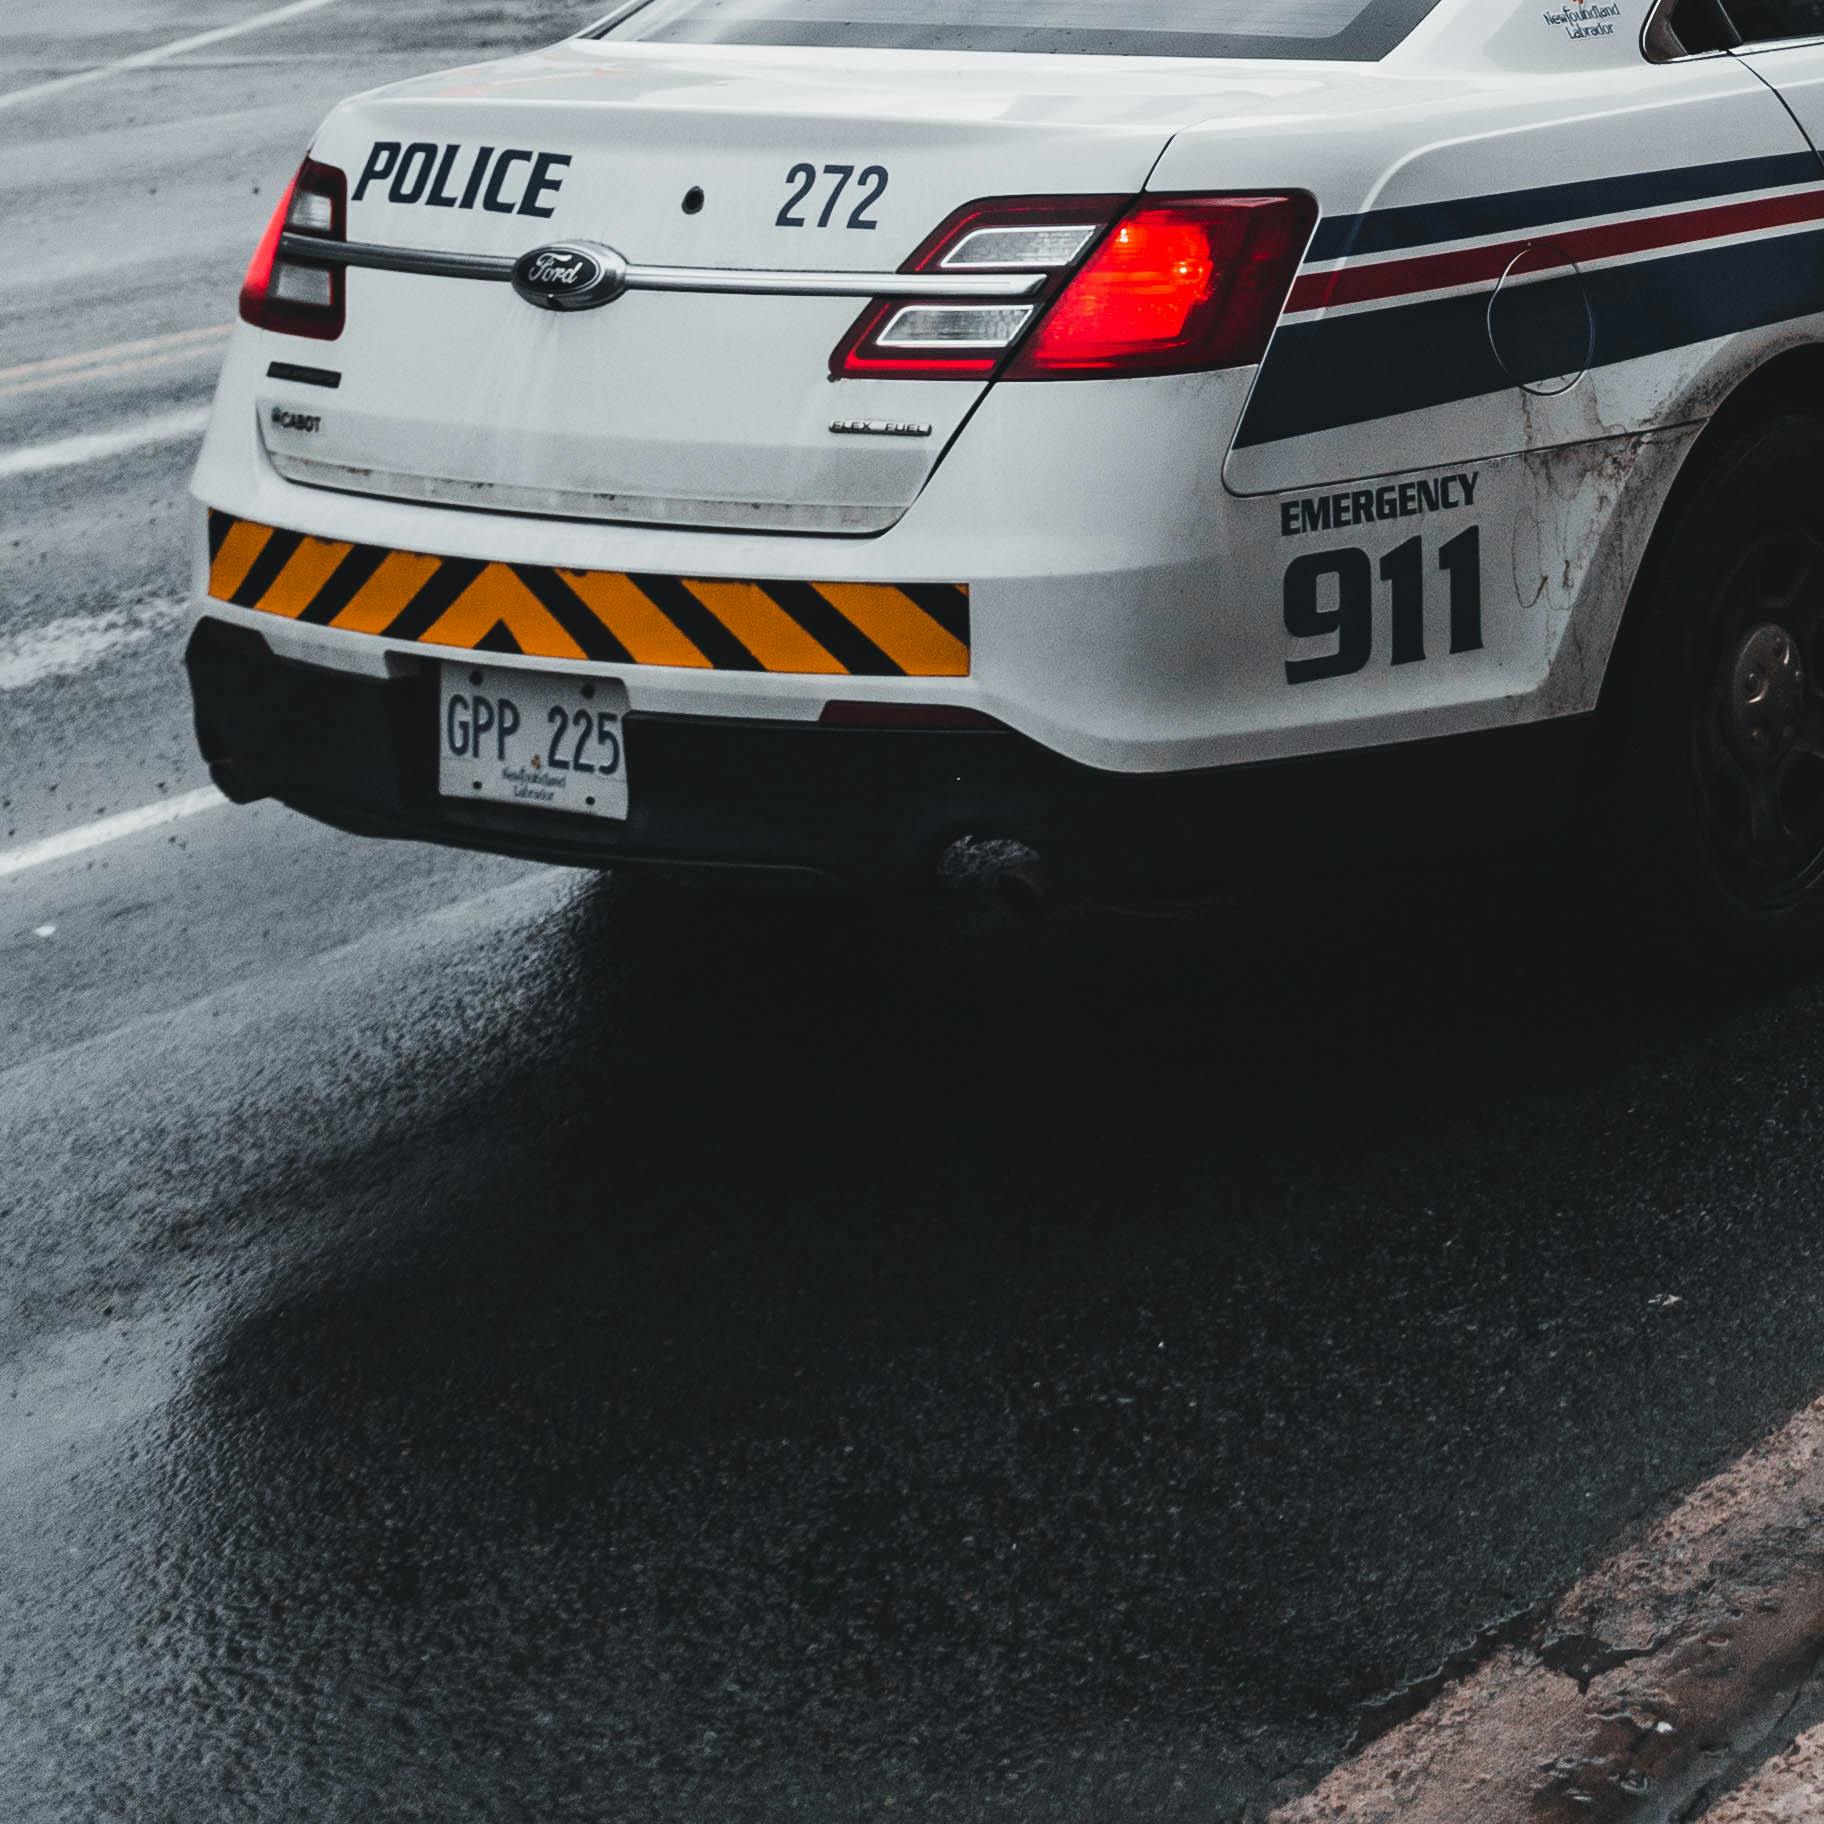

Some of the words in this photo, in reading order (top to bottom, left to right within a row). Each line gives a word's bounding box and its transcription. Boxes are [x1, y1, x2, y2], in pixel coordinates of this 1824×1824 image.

[1543, 2, 1621, 27] Newfoundland
[1565, 22, 1614, 39] Labrador
[352, 140, 572, 219] POLICE
[775, 163, 890, 231] 272
[528, 252, 584, 284] Ford
[830, 421, 871, 432] FLEX
[885, 423, 929, 433] FUEL
[1280, 471, 1480, 538] EMERGENCY
[1283, 525, 1484, 685] 911
[447, 694, 521, 762] GPP
[547, 705, 620, 775] 225
